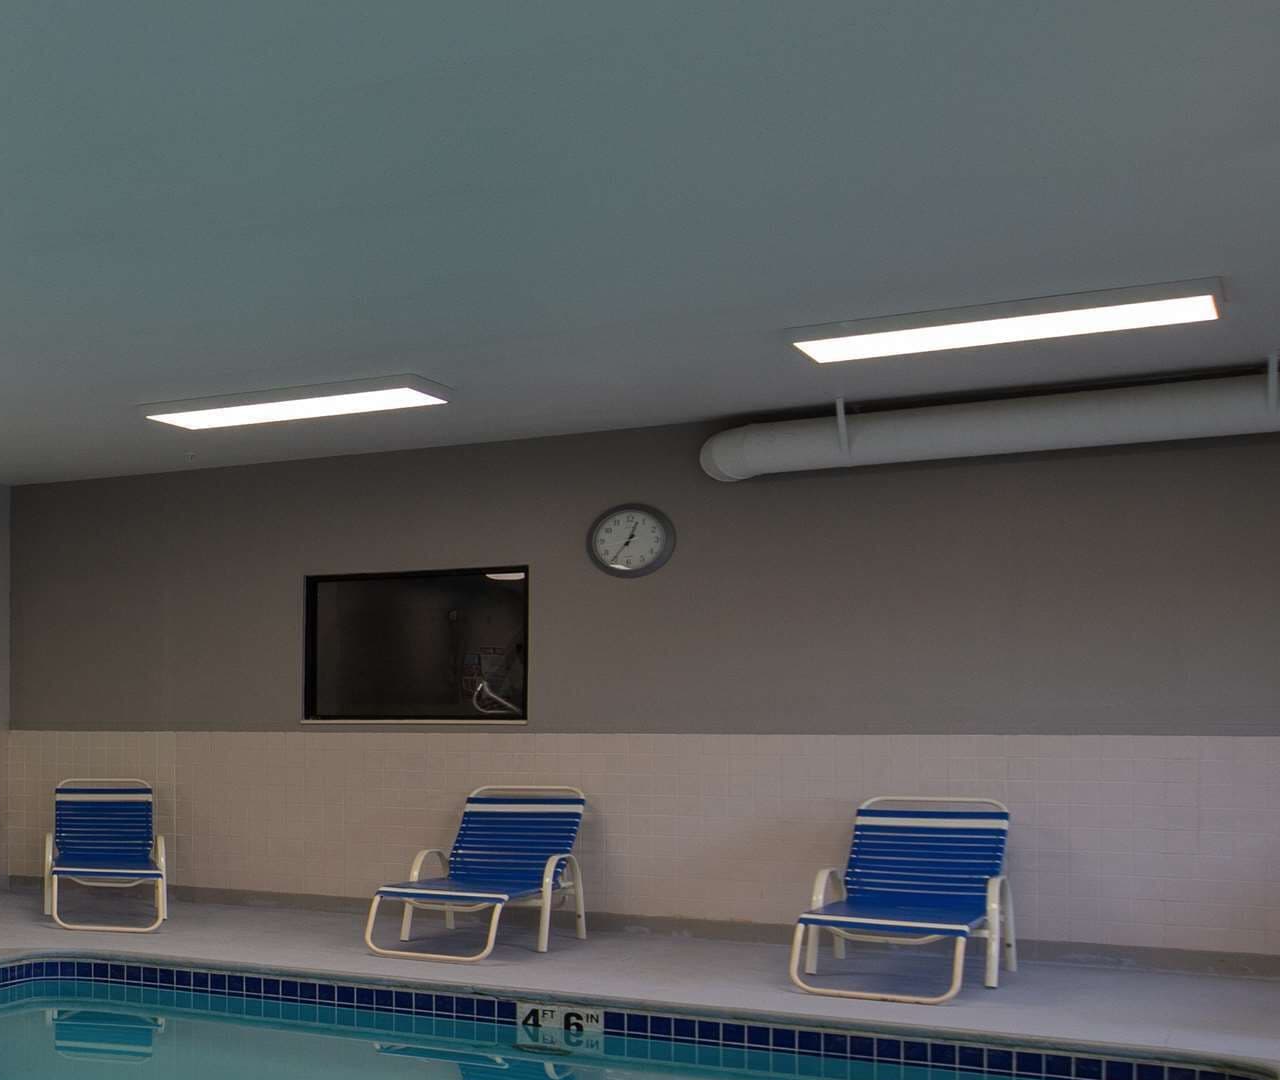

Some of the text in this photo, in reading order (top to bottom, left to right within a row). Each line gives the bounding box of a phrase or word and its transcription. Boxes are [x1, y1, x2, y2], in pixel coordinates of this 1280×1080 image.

[522, 1008, 600, 1034] 4 FT 6 IN
